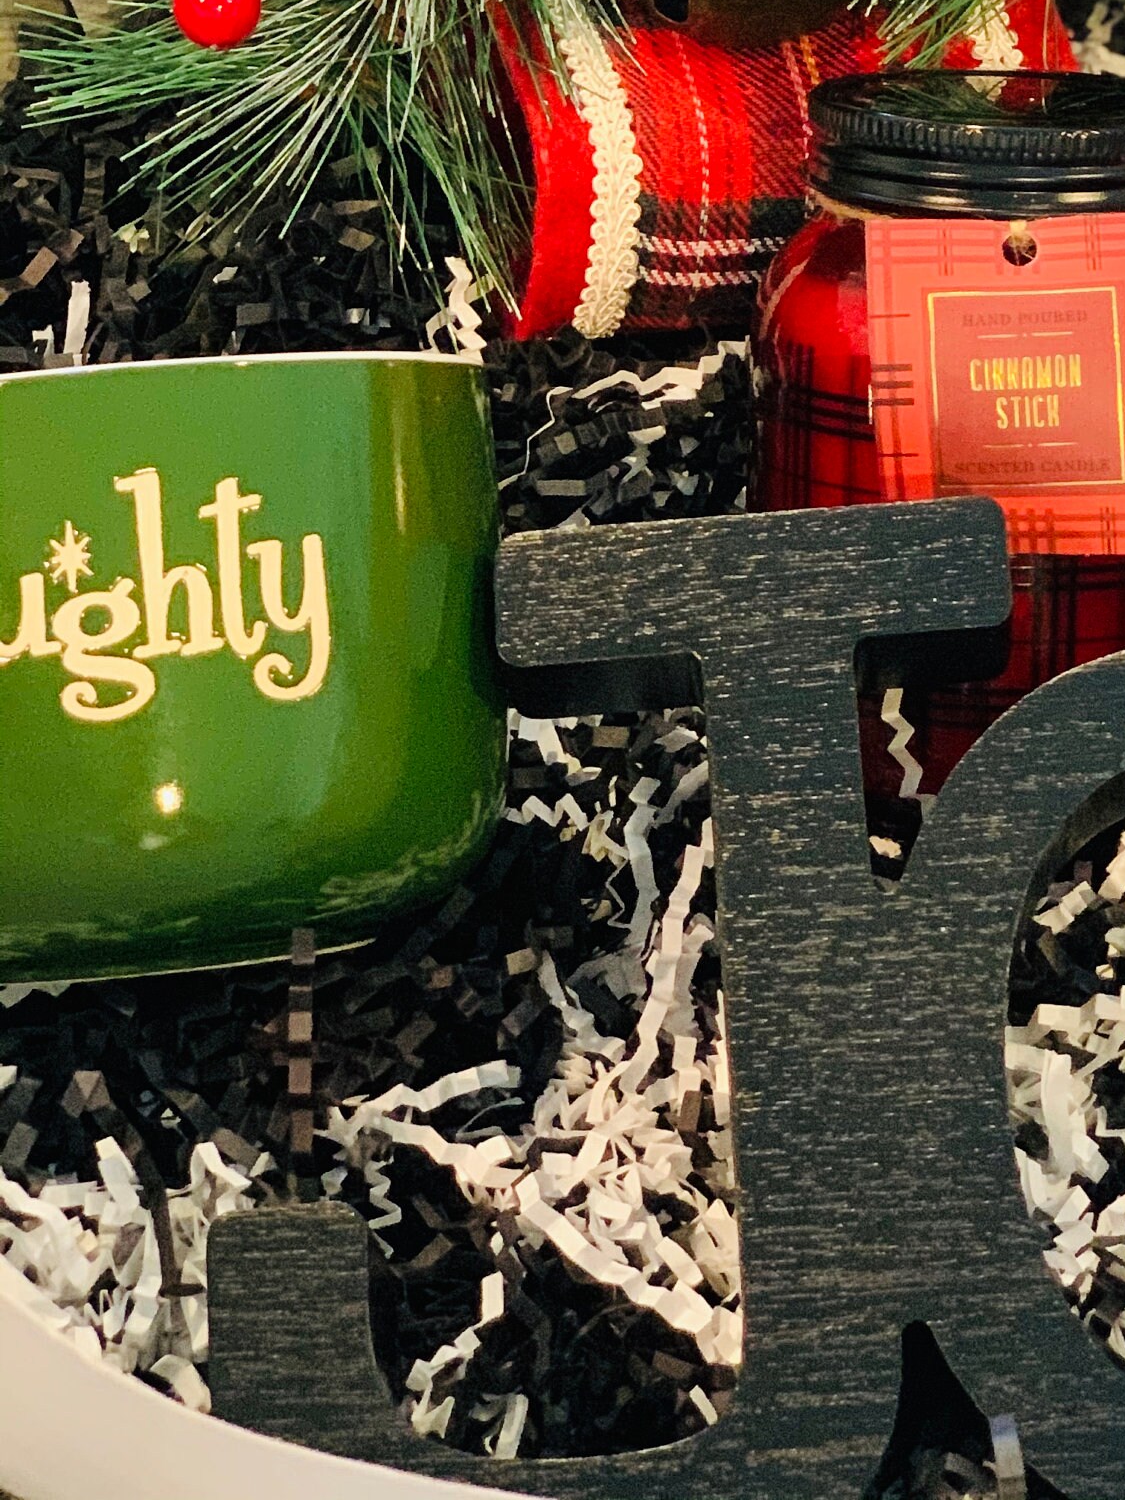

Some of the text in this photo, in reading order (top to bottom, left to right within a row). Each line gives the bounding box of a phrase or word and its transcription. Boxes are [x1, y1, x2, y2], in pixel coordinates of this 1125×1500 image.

[962, 309, 1088, 327] HAND POURED
[969, 354, 1082, 392] CINNAMON
[995, 394, 1060, 429] STICK
[954, 458, 1111, 474] SCENTED CANDLE
